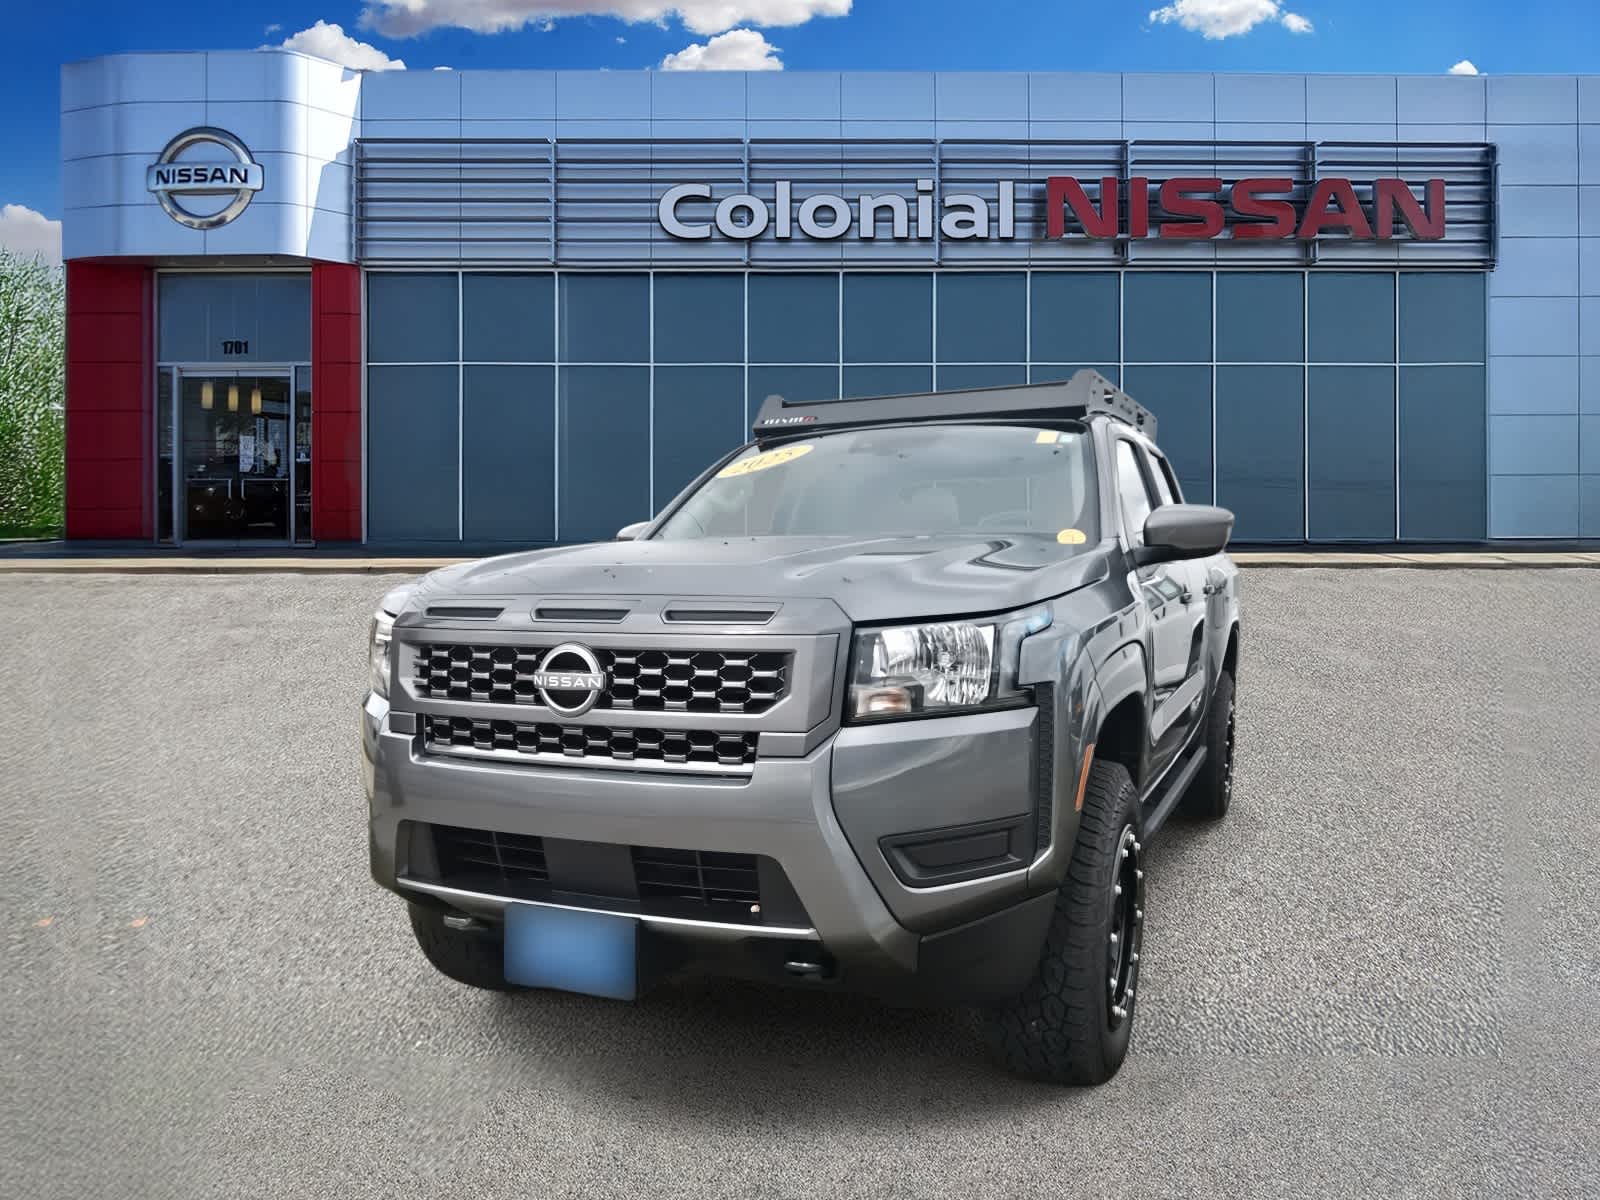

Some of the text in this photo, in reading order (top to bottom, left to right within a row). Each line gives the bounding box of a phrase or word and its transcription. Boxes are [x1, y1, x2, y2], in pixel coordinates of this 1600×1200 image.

[155, 167, 249, 185] NISSAN
[658, 176, 1446, 240] Colonial NISSAN
[222, 340, 249, 354] 1701
[533, 675, 601, 688] NISSAN
